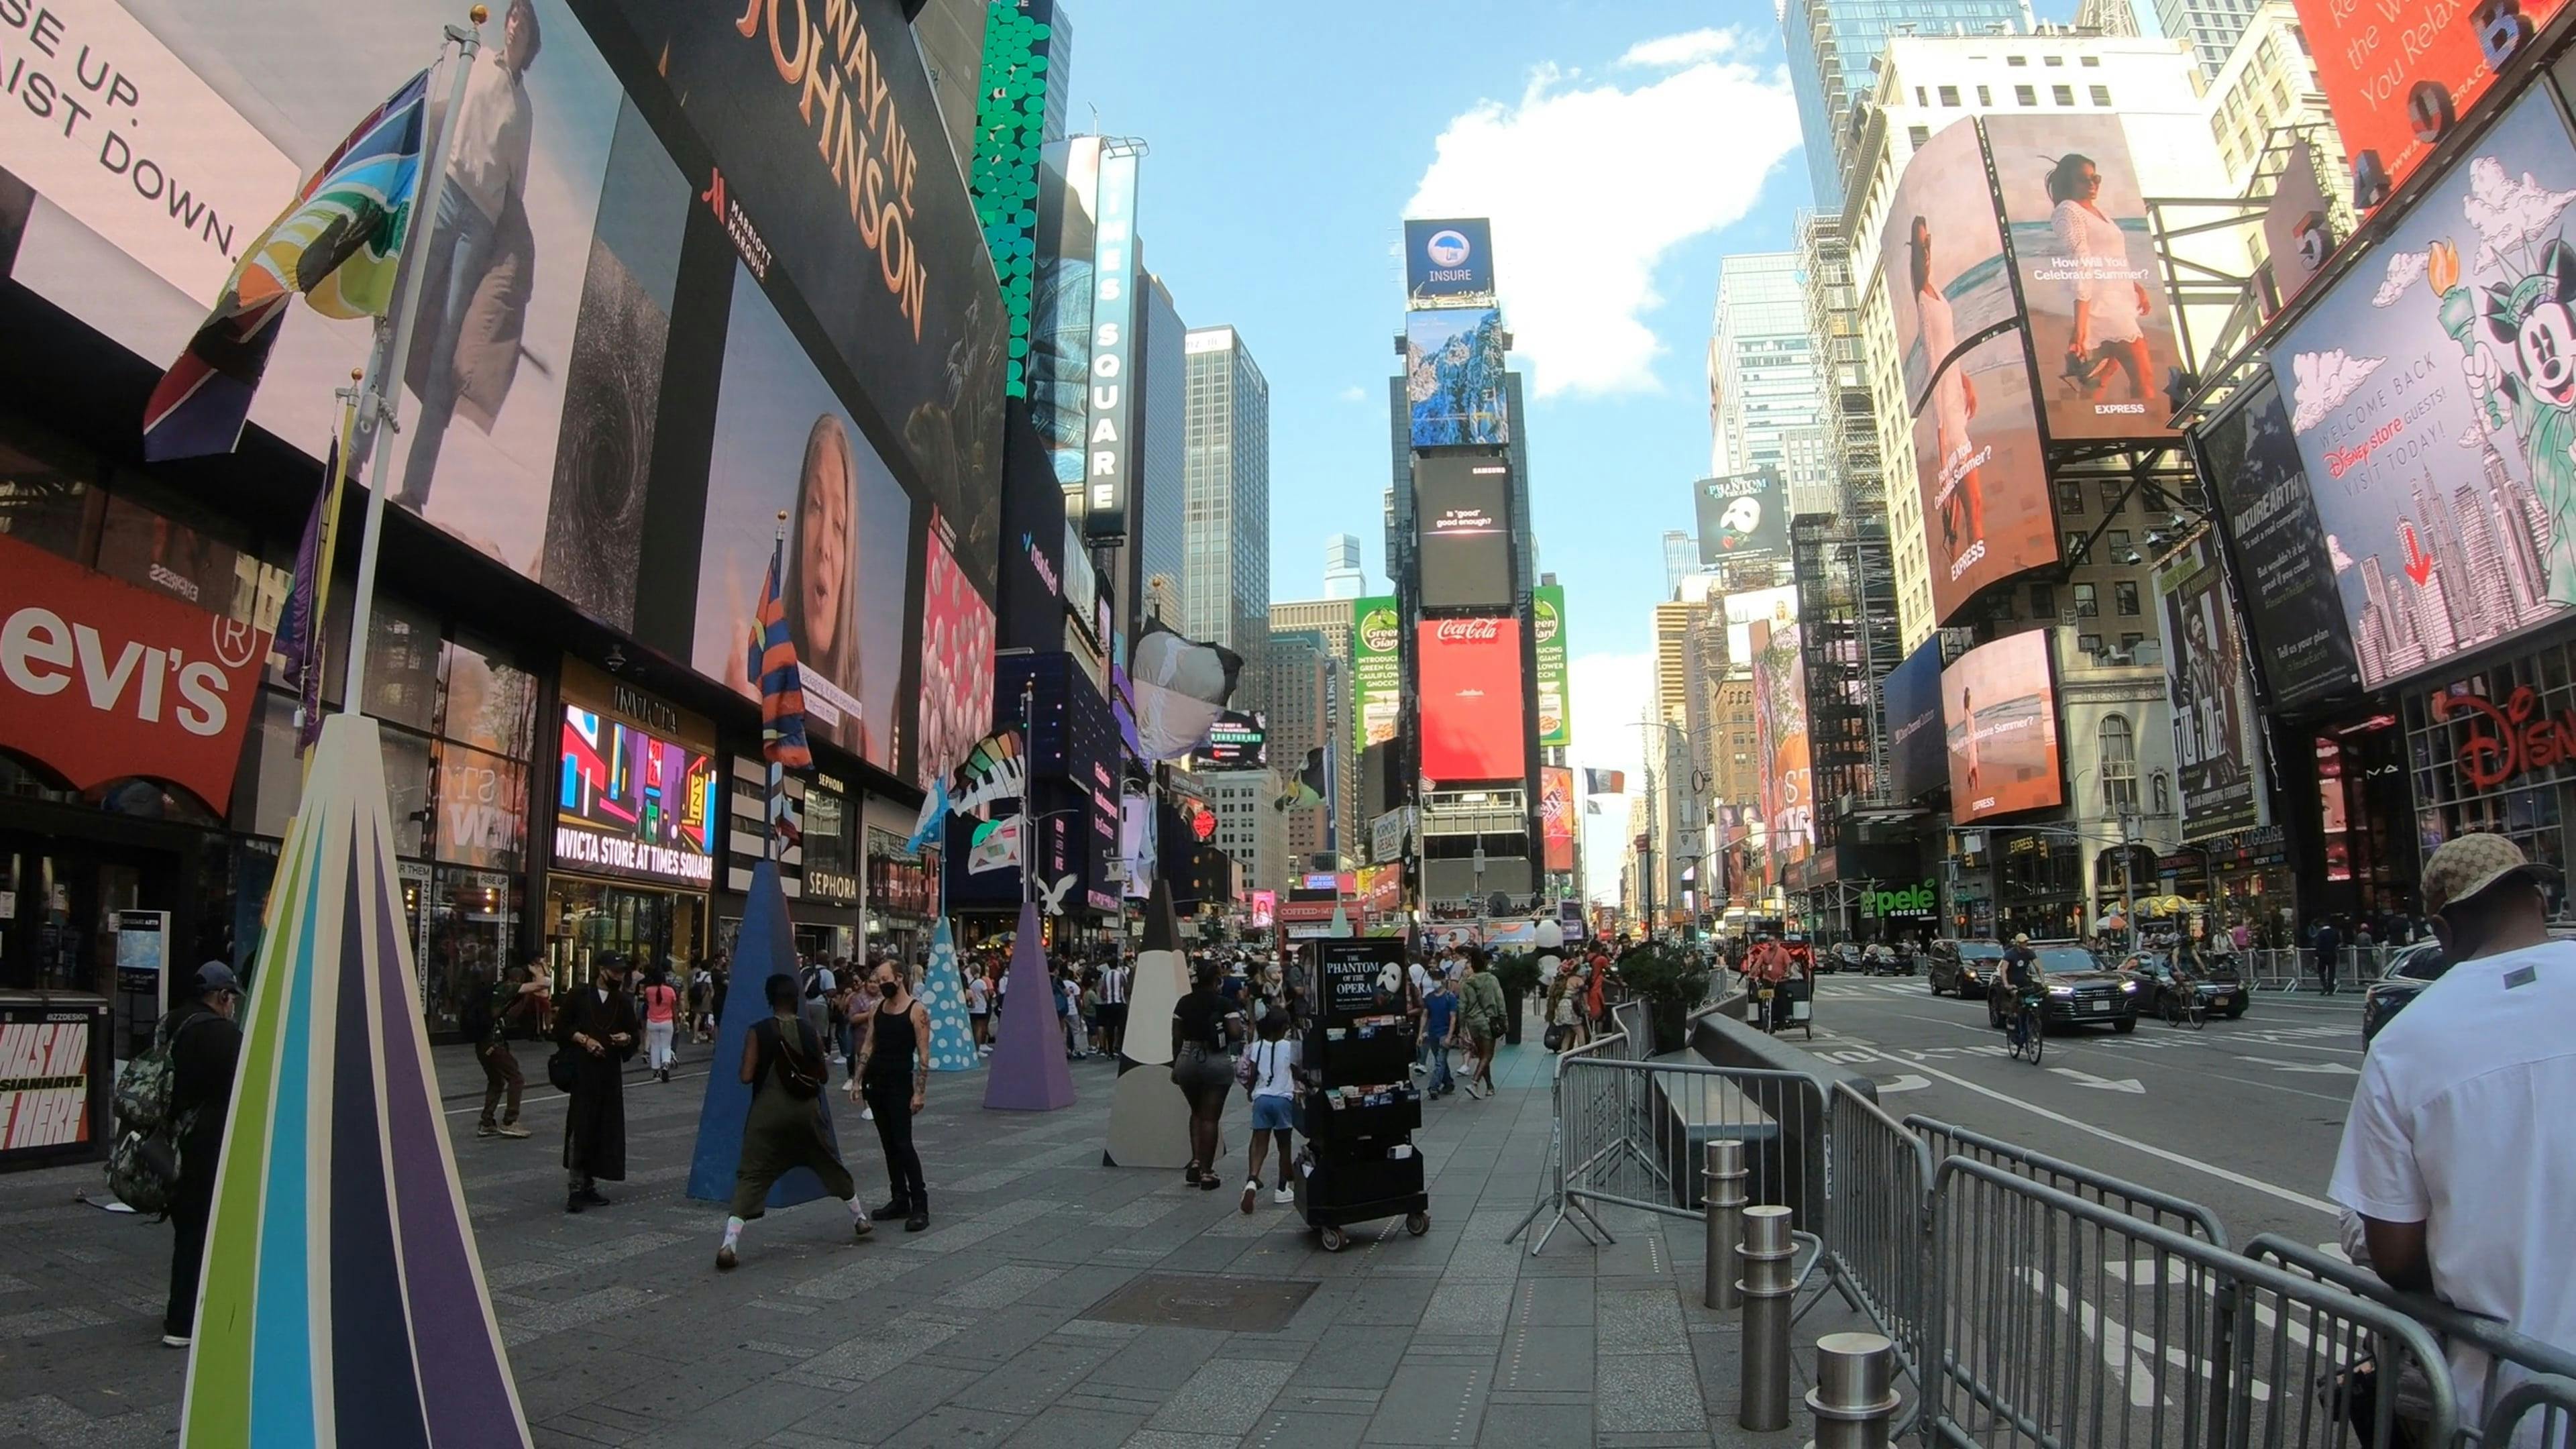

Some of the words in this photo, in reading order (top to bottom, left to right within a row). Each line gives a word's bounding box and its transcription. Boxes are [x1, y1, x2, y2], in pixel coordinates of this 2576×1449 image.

[2347, 25, 2380, 70] the
[76, 44, 139, 127] UP.
[2360, 59, 2404, 111] You
[99, 129, 238, 264] DOWN.
[728, 218, 765, 278] MARQUIS
[731, 199, 772, 266] MARRIOTT
[1430, 269, 1472, 282] INSURE
[2034, 270, 2092, 280] Celebrate
[2094, 270, 2148, 280] Summer?
[2052, 258, 2078, 268] How
[2082, 257, 2102, 268] Will
[2104, 257, 2127, 268] You
[1092, 323, 1120, 509] SQUARE
[2095, 404, 2145, 414] EXPRESS
[2319, 388, 2387, 449] WELCOME
[2393, 352, 2436, 396] BACK
[2371, 418, 2403, 449] store
[2404, 386, 2447, 424] GUESTS!
[1954, 445, 1992, 484] Summer?
[2345, 463, 2381, 498] VISIT
[2387, 421, 2446, 470] TODAY!
[1437, 519, 1457, 528] good
[1458, 517, 1492, 527] enough?
[1951, 539, 1985, 582] EXPRESS
[1437, 619, 1497, 641] Coca-Cola
[614, 686, 678, 735] INVICTA
[1994, 716, 2033, 736] Summer?
[818, 772, 844, 794] SEPHORA
[408, 865, 429, 876] THEM
[556, 827, 598, 863] NVICTA
[601, 836, 635, 869] STORE
[636, 844, 649, 870] AT
[650, 847, 679, 875] TIMES
[809, 871, 857, 900] SEPHORA
[1876, 878, 1935, 917] pelé
[1890, 909, 1928, 917] SOCCER
[1326, 962, 1380, 974] PHANTOM
[1336, 983, 1372, 994] OPERA
